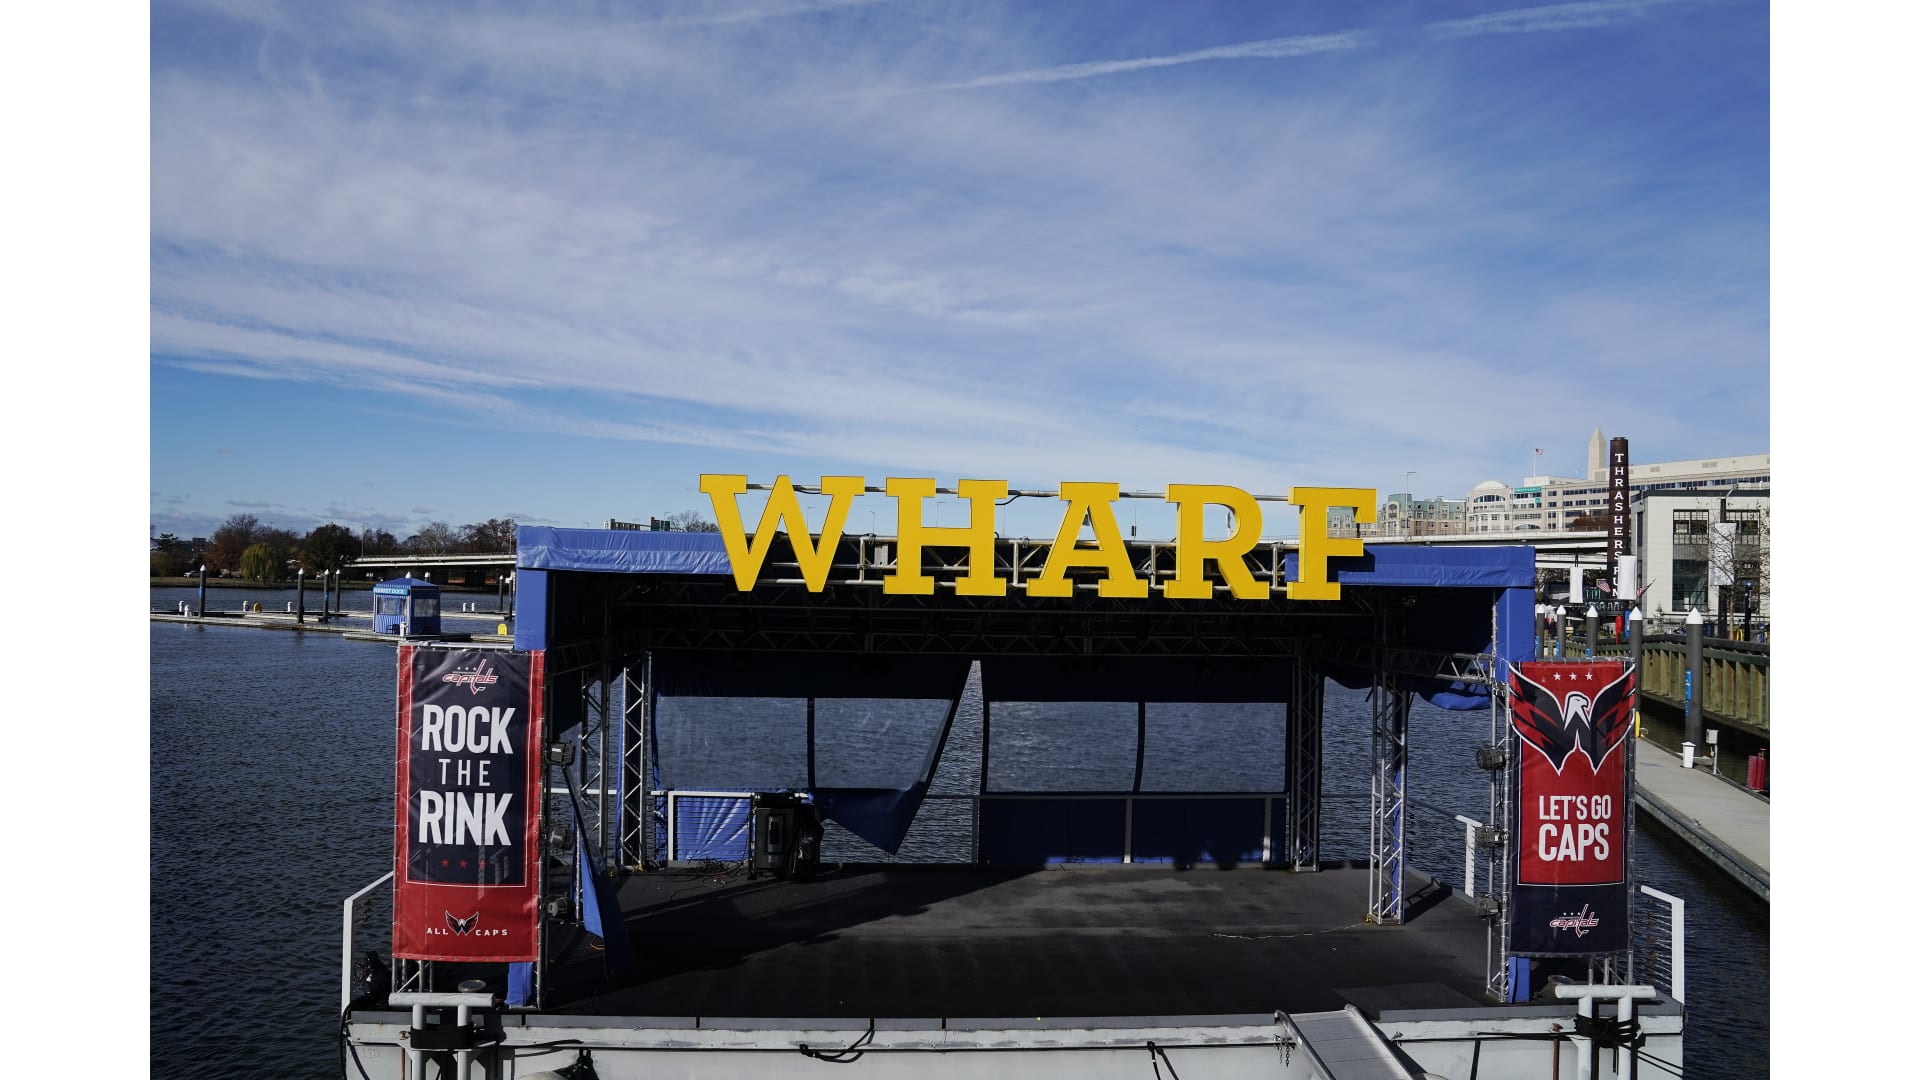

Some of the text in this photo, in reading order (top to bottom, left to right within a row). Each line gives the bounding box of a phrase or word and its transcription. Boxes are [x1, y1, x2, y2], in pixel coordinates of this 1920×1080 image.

[1614, 453, 1624, 560] THRASHERS
[700, 474, 1377, 601] WHARF
[421, 704, 516, 755] ROCK
[438, 758, 491, 787] THE
[418, 790, 513, 846] RINK
[1539, 795, 1611, 820] LET'S GO
[1538, 823, 1610, 862] CAPS
[426, 927, 508, 937] ALL CAPS
